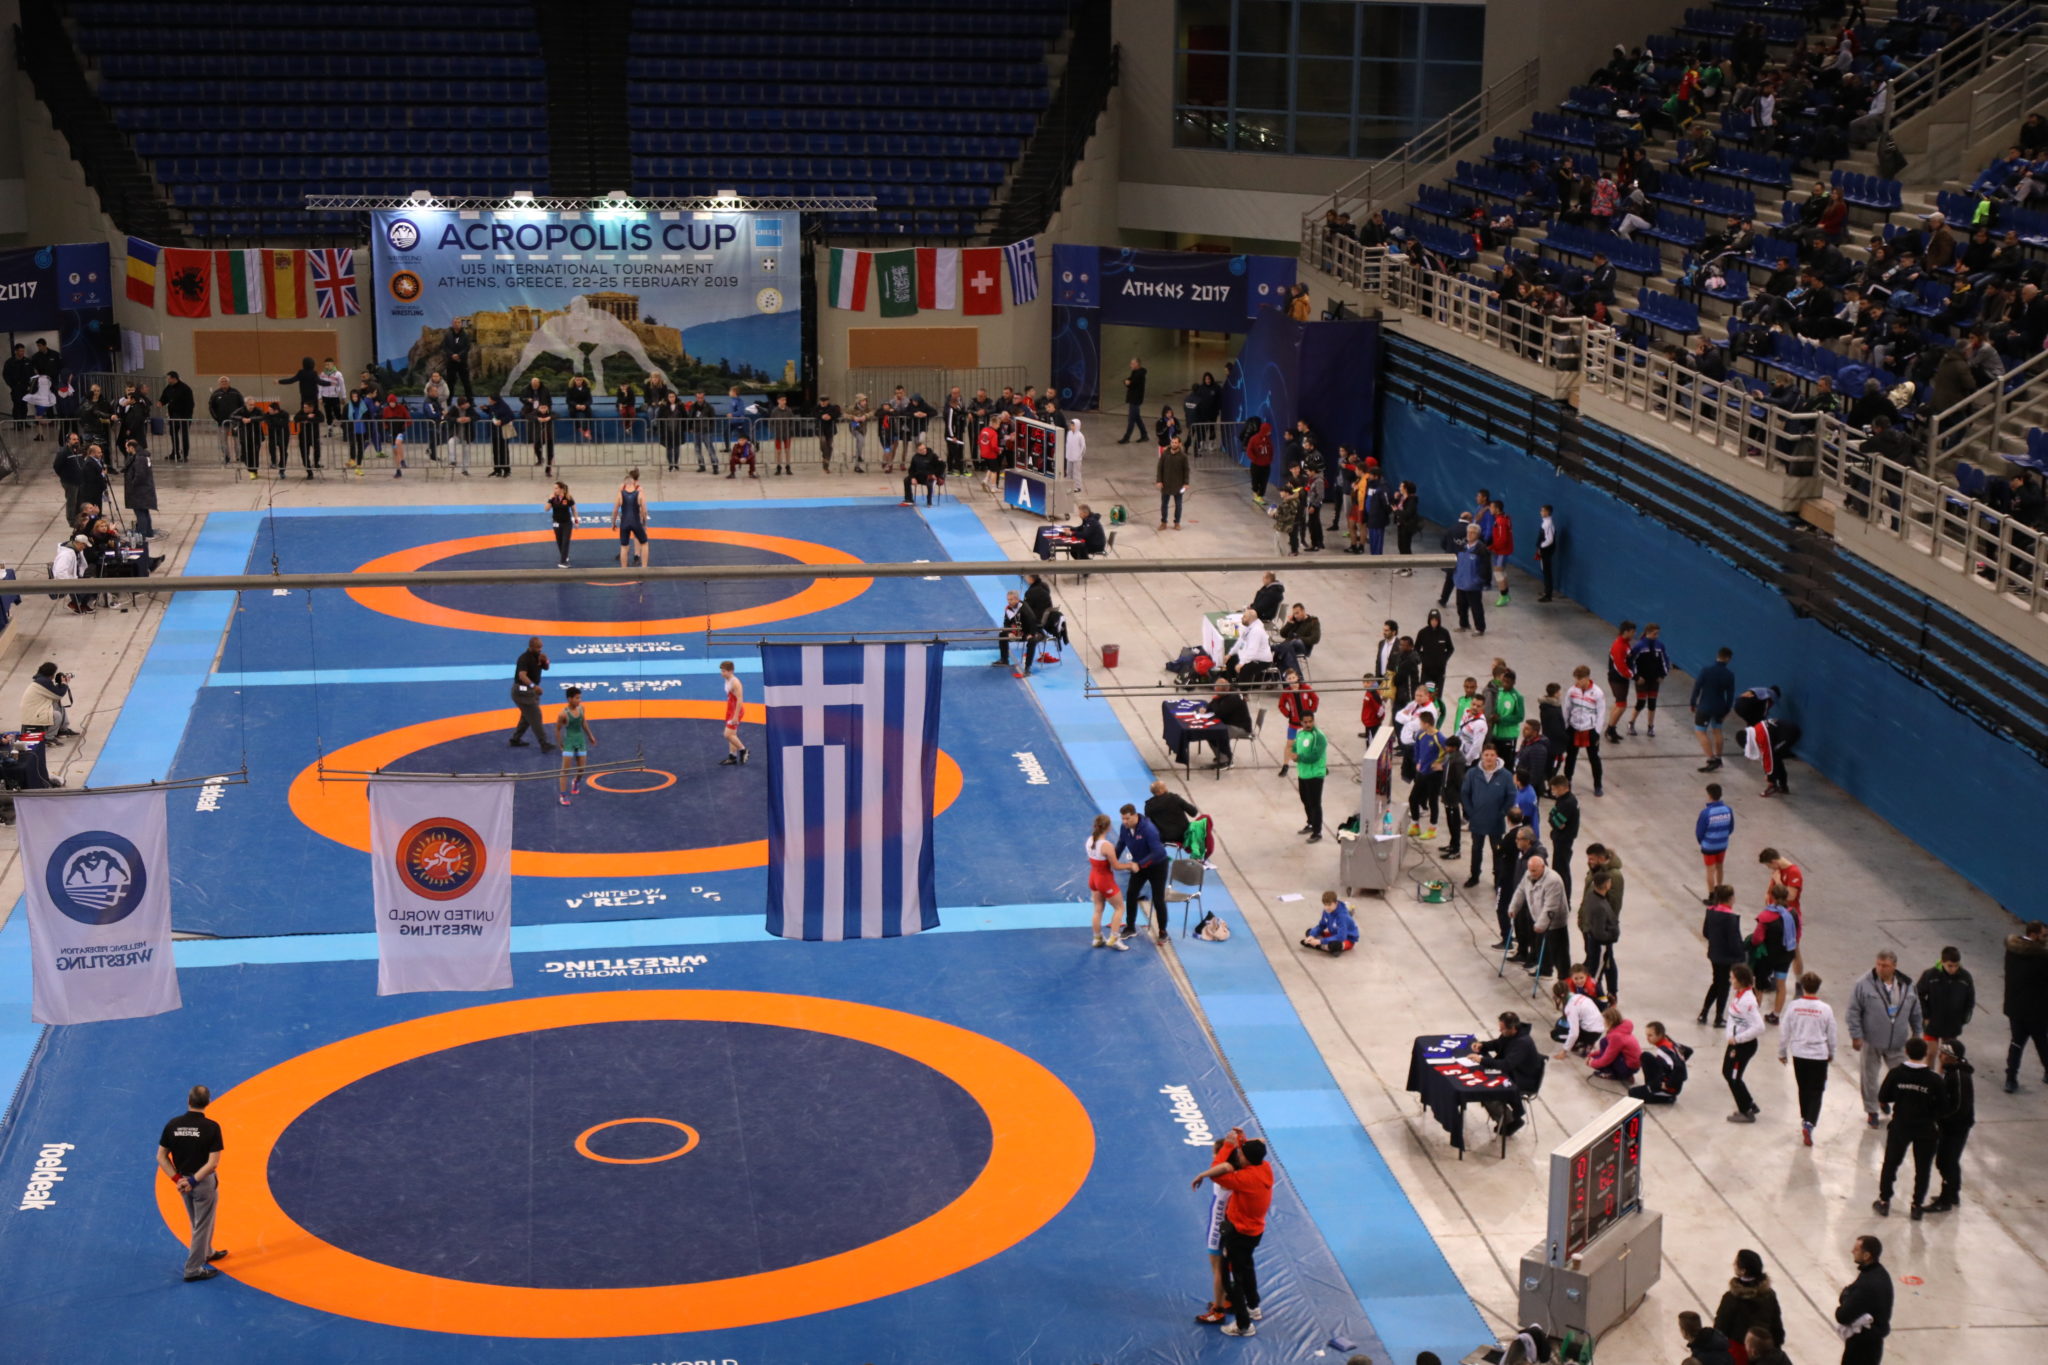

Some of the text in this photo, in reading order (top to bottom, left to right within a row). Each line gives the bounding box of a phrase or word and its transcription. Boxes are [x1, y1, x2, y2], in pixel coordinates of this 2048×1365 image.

[437, 223, 737, 251] ACROPOLIS CUP
[461, 263, 714, 275] U15 INTERNATIONAL TOURNAMENT
[438, 276, 739, 289] ATHENS, GREECE, 22-25 FEBRUARY 2019
[1017, 478, 1032, 508] A
[566, 644, 686, 655] WRESTLING
[545, 954, 708, 974] WRESTLING
[563, 965, 694, 979] UNITED WORLD
[1159, 1084, 1216, 1146] foeldeak
[19, 1142, 75, 1211] foeldeak
